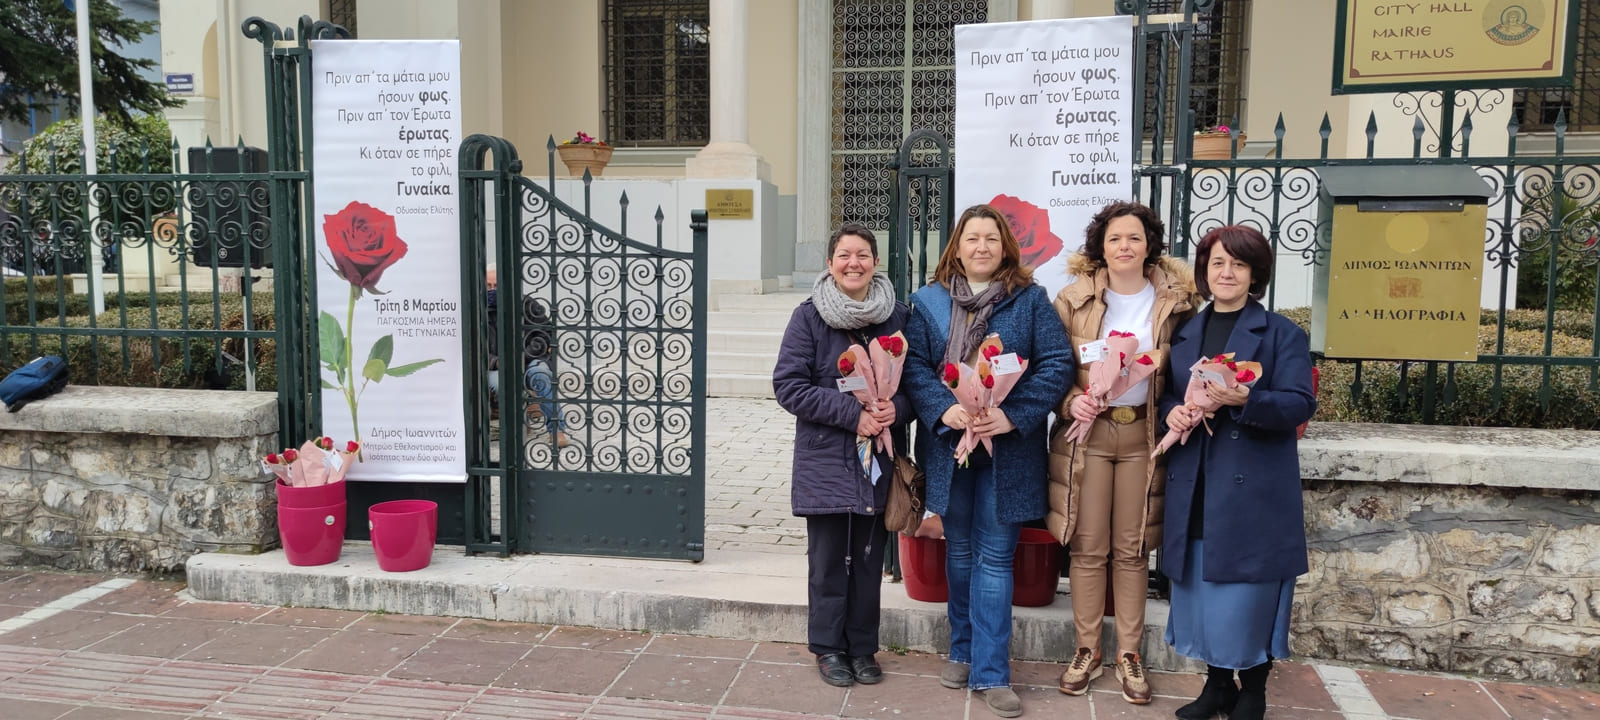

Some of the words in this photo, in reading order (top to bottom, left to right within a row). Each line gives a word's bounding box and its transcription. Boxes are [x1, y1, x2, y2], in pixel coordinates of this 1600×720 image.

[1374, 4, 1421, 16] CITY
[1430, 2, 1472, 12] HALL
[1373, 26, 1431, 39] MAIRIE
[971, 52, 1001, 68] Πριν
[1052, 46, 1089, 64] μάτια
[1094, 48, 1120, 61] μου
[1371, 48, 1454, 61] RATHAUS
[326, 72, 351, 86] Πριν
[394, 70, 425, 85] μάτια
[429, 72, 450, 84] μου
[1034, 70, 1076, 86] ήσουν
[1082, 68, 1120, 84] φως.
[378, 90, 414, 105] ήσουν
[419, 91, 451, 105] φως.
[985, 93, 1015, 109] Πριν
[1072, 87, 1120, 104] Έρωτα
[338, 109, 364, 124] Πριν
[411, 108, 451, 122] Έρωτα
[1056, 108, 1120, 128] έρωτας.
[399, 126, 452, 143] έρωτας.
[1010, 133, 1022, 147] Κι
[1027, 133, 1059, 146] όταν
[1064, 134, 1080, 144] σε
[1085, 129, 1119, 146] πήρε
[360, 147, 372, 159] Κι
[375, 147, 402, 159] όταν
[406, 148, 420, 158] σε
[424, 146, 452, 160] πήρε
[1069, 153, 1084, 163] το
[411, 166, 424, 176] το
[1052, 168, 1120, 186] Γυναίκα.
[397, 180, 453, 196] Γυναίκα.
[1050, 198, 1089, 207] Οδυσσέας
[396, 206, 428, 214] Οδυσσέας
[431, 206, 453, 215] Ελύτης
[1343, 261, 1390, 270] ΔΗΜΟΣ
[374, 299, 400, 314] Τρίτη
[404, 300, 409, 311] 8
[413, 299, 456, 314] Μαρτίου
[377, 317, 424, 325] ΠΑΓΚΟΣΜΙΑ
[372, 427, 402, 439] Δήμος
[406, 428, 457, 437] Ιωαννιτών
